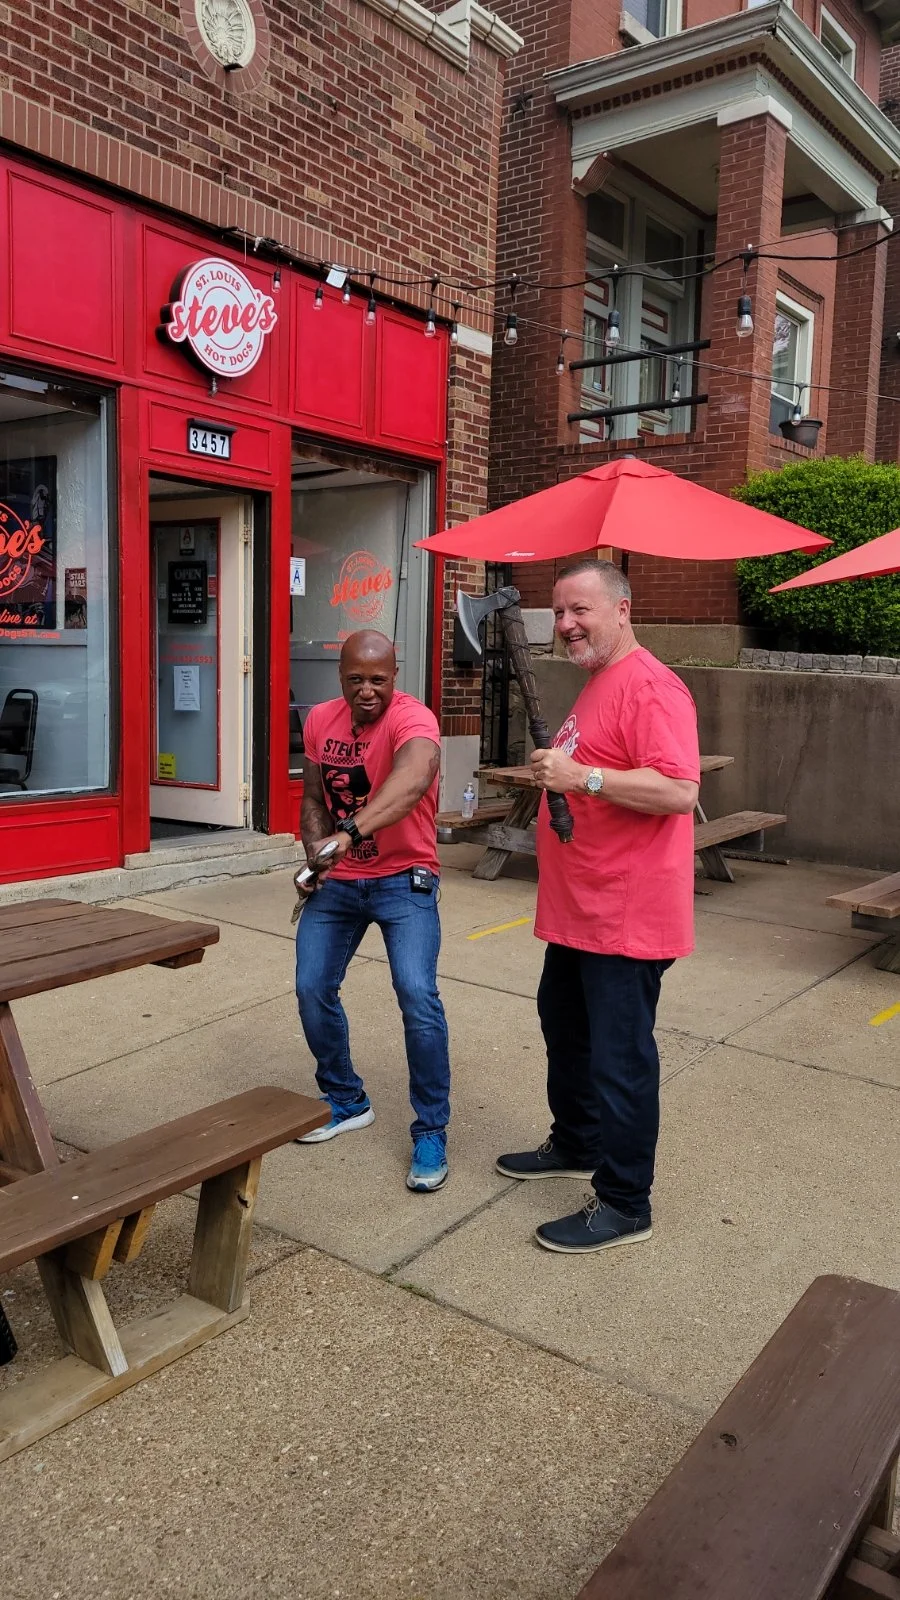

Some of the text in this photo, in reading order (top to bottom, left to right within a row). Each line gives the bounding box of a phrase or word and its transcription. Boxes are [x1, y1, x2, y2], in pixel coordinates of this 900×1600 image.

[195, 270, 242, 291] ST. LOUIS
[171, 292, 276, 339] steve's
[204, 341, 253, 366] HOT DOGS
[192, 430, 226, 455] 3457
[174, 568, 202, 580] OPEN
[293, 569, 301, 584] A
[24, 613, 38, 624] at
